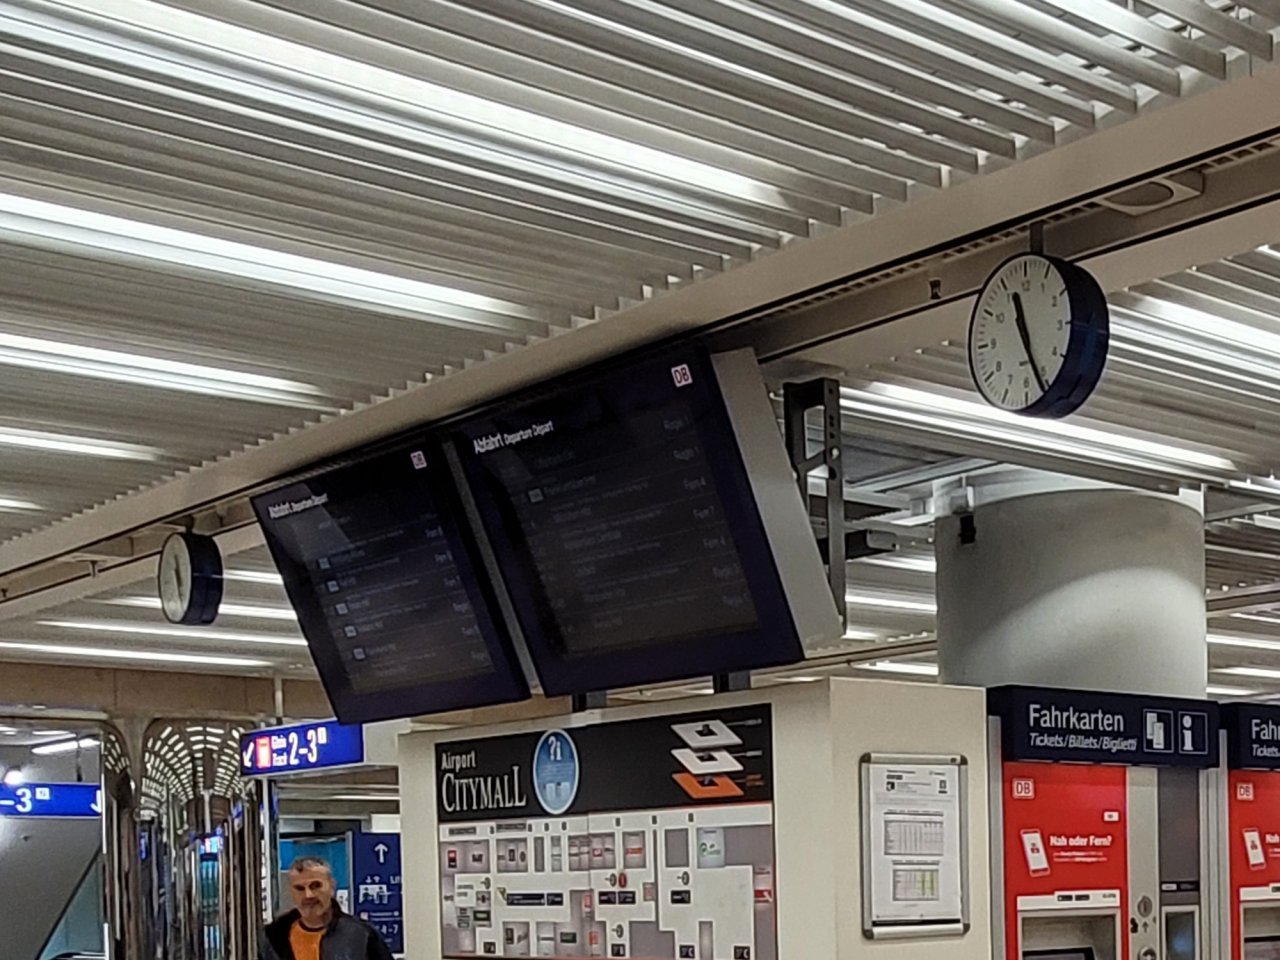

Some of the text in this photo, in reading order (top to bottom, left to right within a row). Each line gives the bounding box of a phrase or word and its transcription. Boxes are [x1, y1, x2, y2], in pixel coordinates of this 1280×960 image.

[672, 365, 692, 386] DB
[1029, 704, 1124, 732] Fahrkarten
[288, 729, 318, 766] 2-3
[441, 751, 477, 773] Airport
[442, 766, 527, 812] CITYMALL
[1015, 781, 1032, 796] DB
